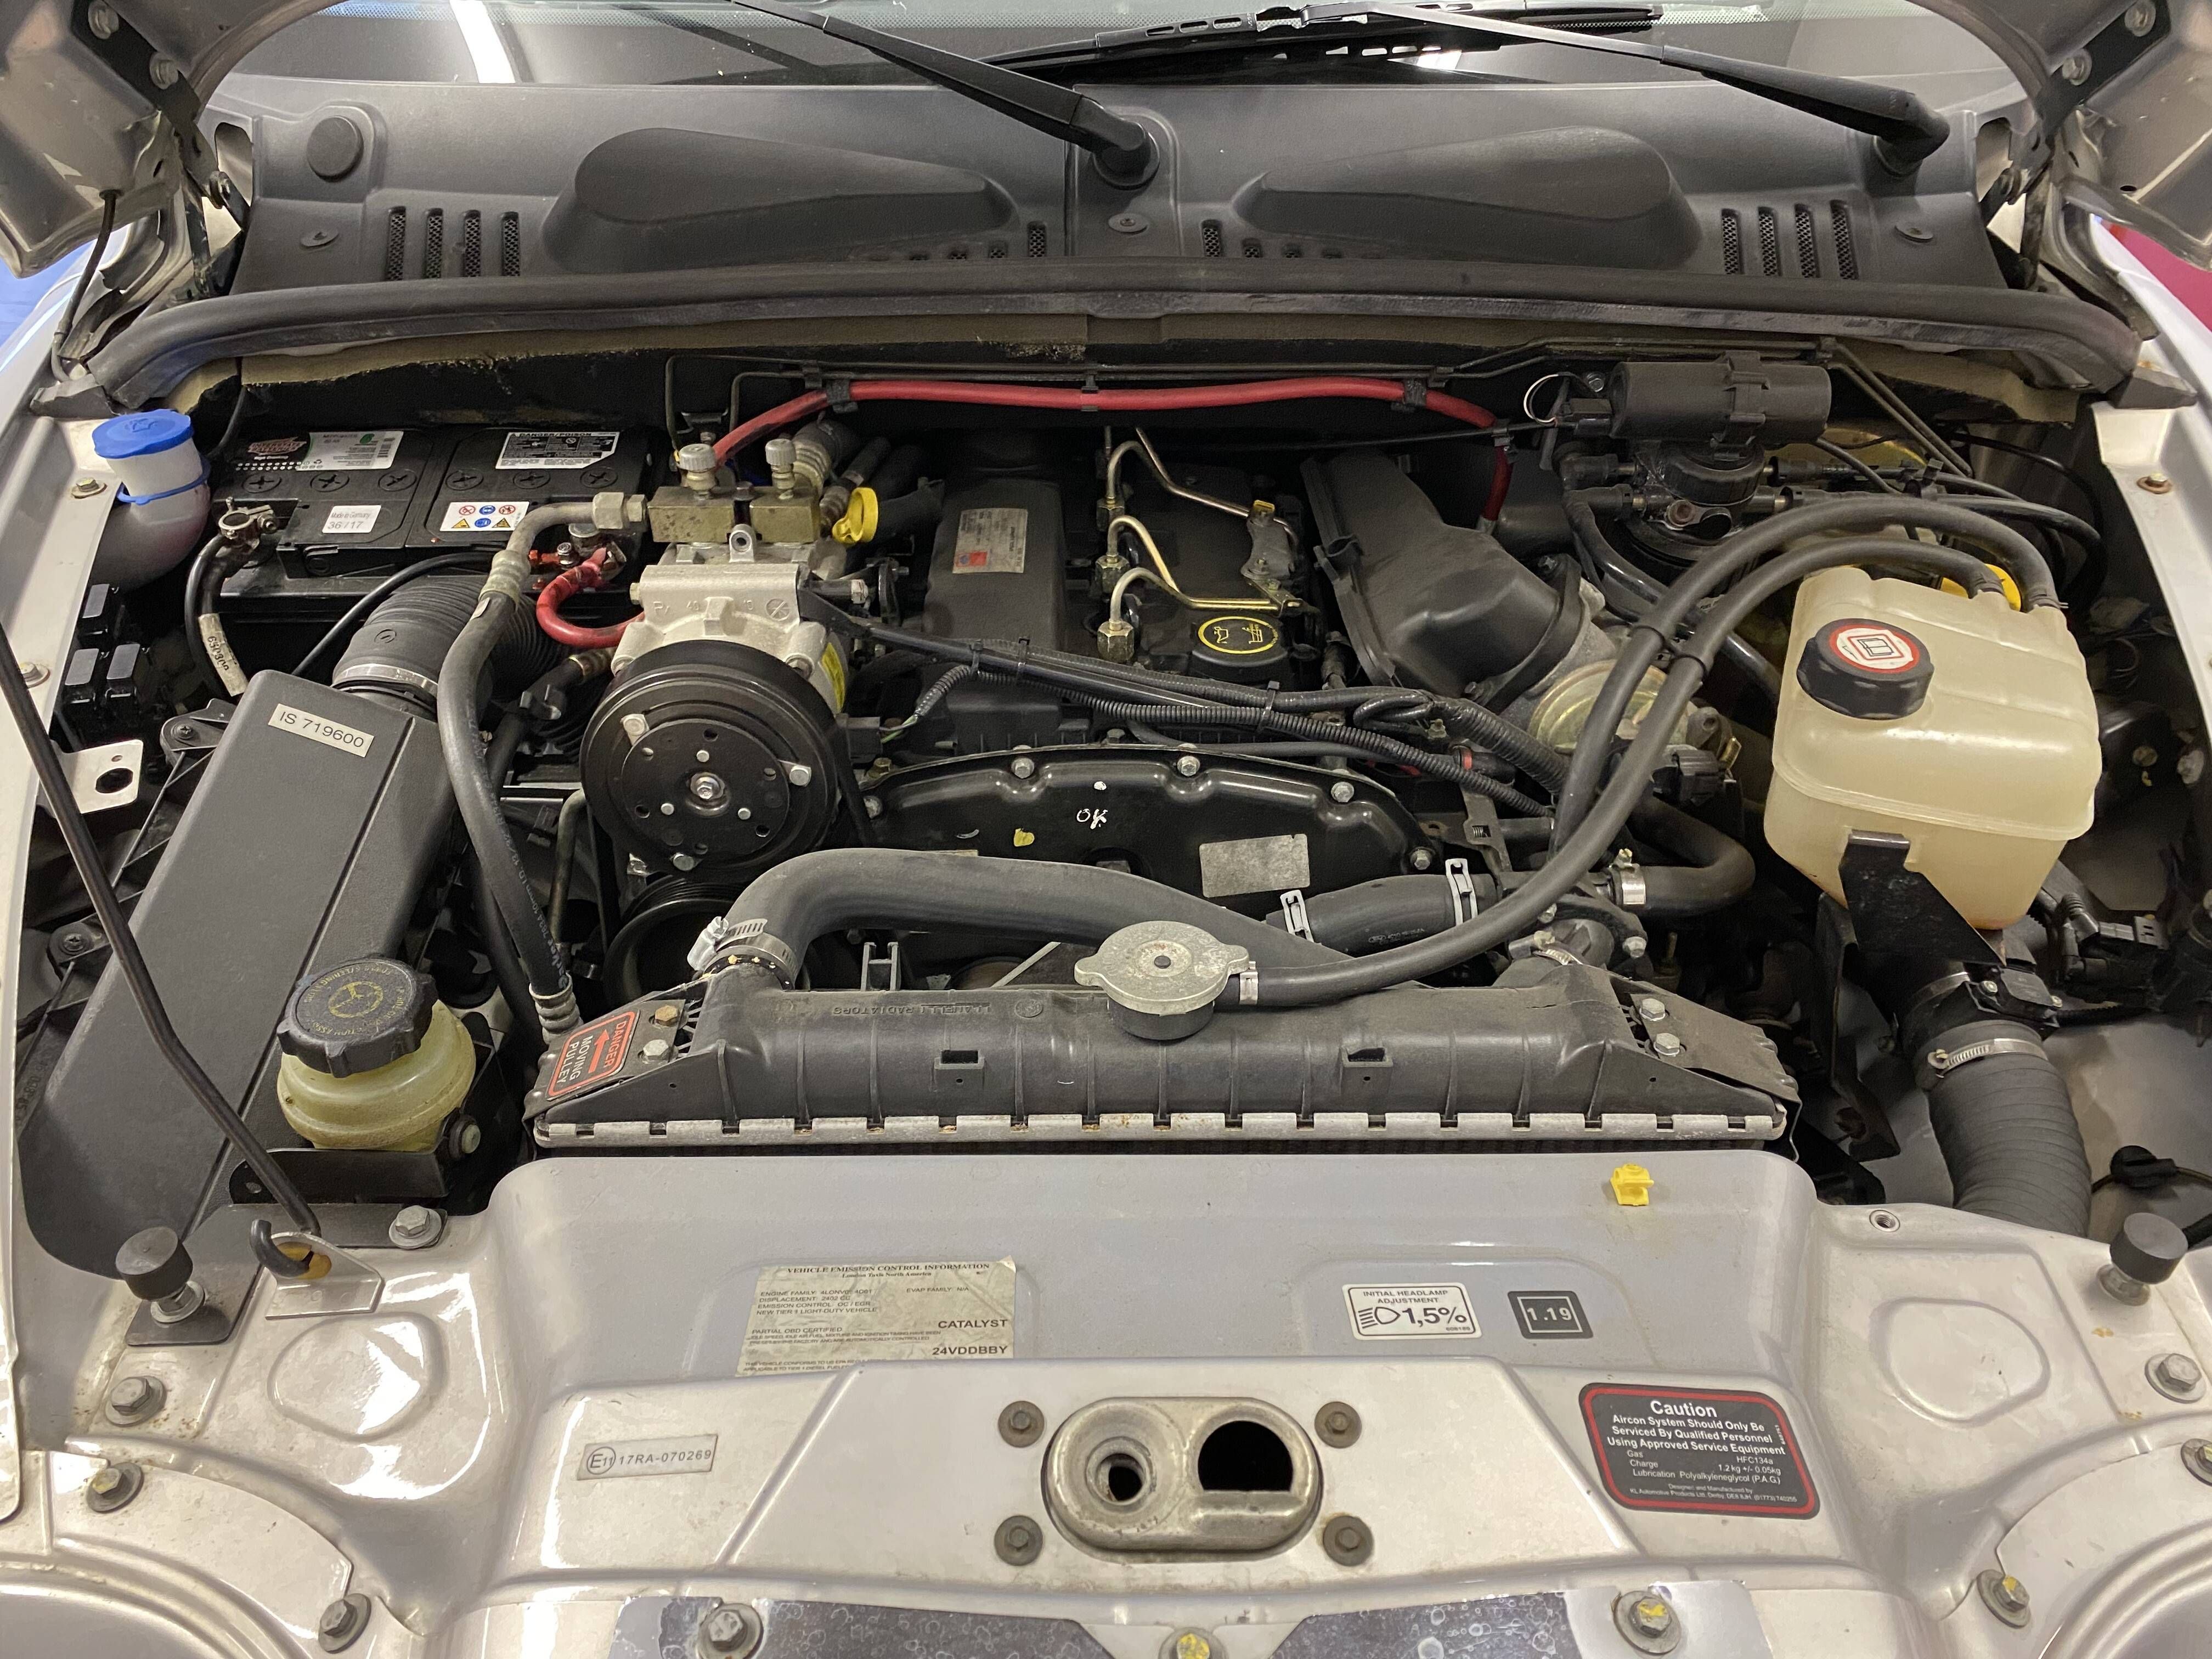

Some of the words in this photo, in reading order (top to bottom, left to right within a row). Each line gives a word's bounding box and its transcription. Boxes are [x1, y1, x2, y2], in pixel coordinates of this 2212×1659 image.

[279, 712, 297, 724] IS
[302, 719, 364, 747] 719600
[1076, 808, 1108, 830] OK
[526, 884, 539, 915] 10mm
[603, 1020, 627, 1069] DANGER
[556, 1041, 580, 1084] PULLEY
[569, 1035, 594, 1081] MOVING
[938, 1319, 1008, 1328] CATALYST
[1402, 1307, 1468, 1327] 1,5%
[1526, 1307, 1572, 1322] 1.19
[932, 1346, 1008, 1355] 24VDDBBY
[1650, 1400, 1718, 1418] Caution
[1613, 1414, 1646, 1425] Aircon
[1647, 1417, 1686, 1428] System
[1688, 1419, 1724, 1430] Should
[1725, 1421, 1749, 1433] Only
[1752, 1423, 1765, 1432] Be
[1612, 1426, 1657, 1437] Serviced
[1659, 1429, 1672, 1440] By
[1675, 1430, 1720, 1441] Qualified
[1722, 1432, 1773, 1443] Personnel
[1607, 1436, 1638, 1449] Using
[1640, 1439, 1690, 1452] Approved
[1691, 1441, 1729, 1452] Service
[1730, 1443, 1786, 1457] Equipment
[618, 1449, 712, 1465] 17RA-070269
[1736, 1455, 1774, 1465] HFC134a
[1630, 1459, 1658, 1469] Charge
[1731, 1465, 1741, 1474] kg
[1755, 1466, 1781, 1476] 0.05kg
[1633, 1469, 1675, 1479] Lubrication
[1680, 1471, 1750, 1483] Polyalkyleneglycol
